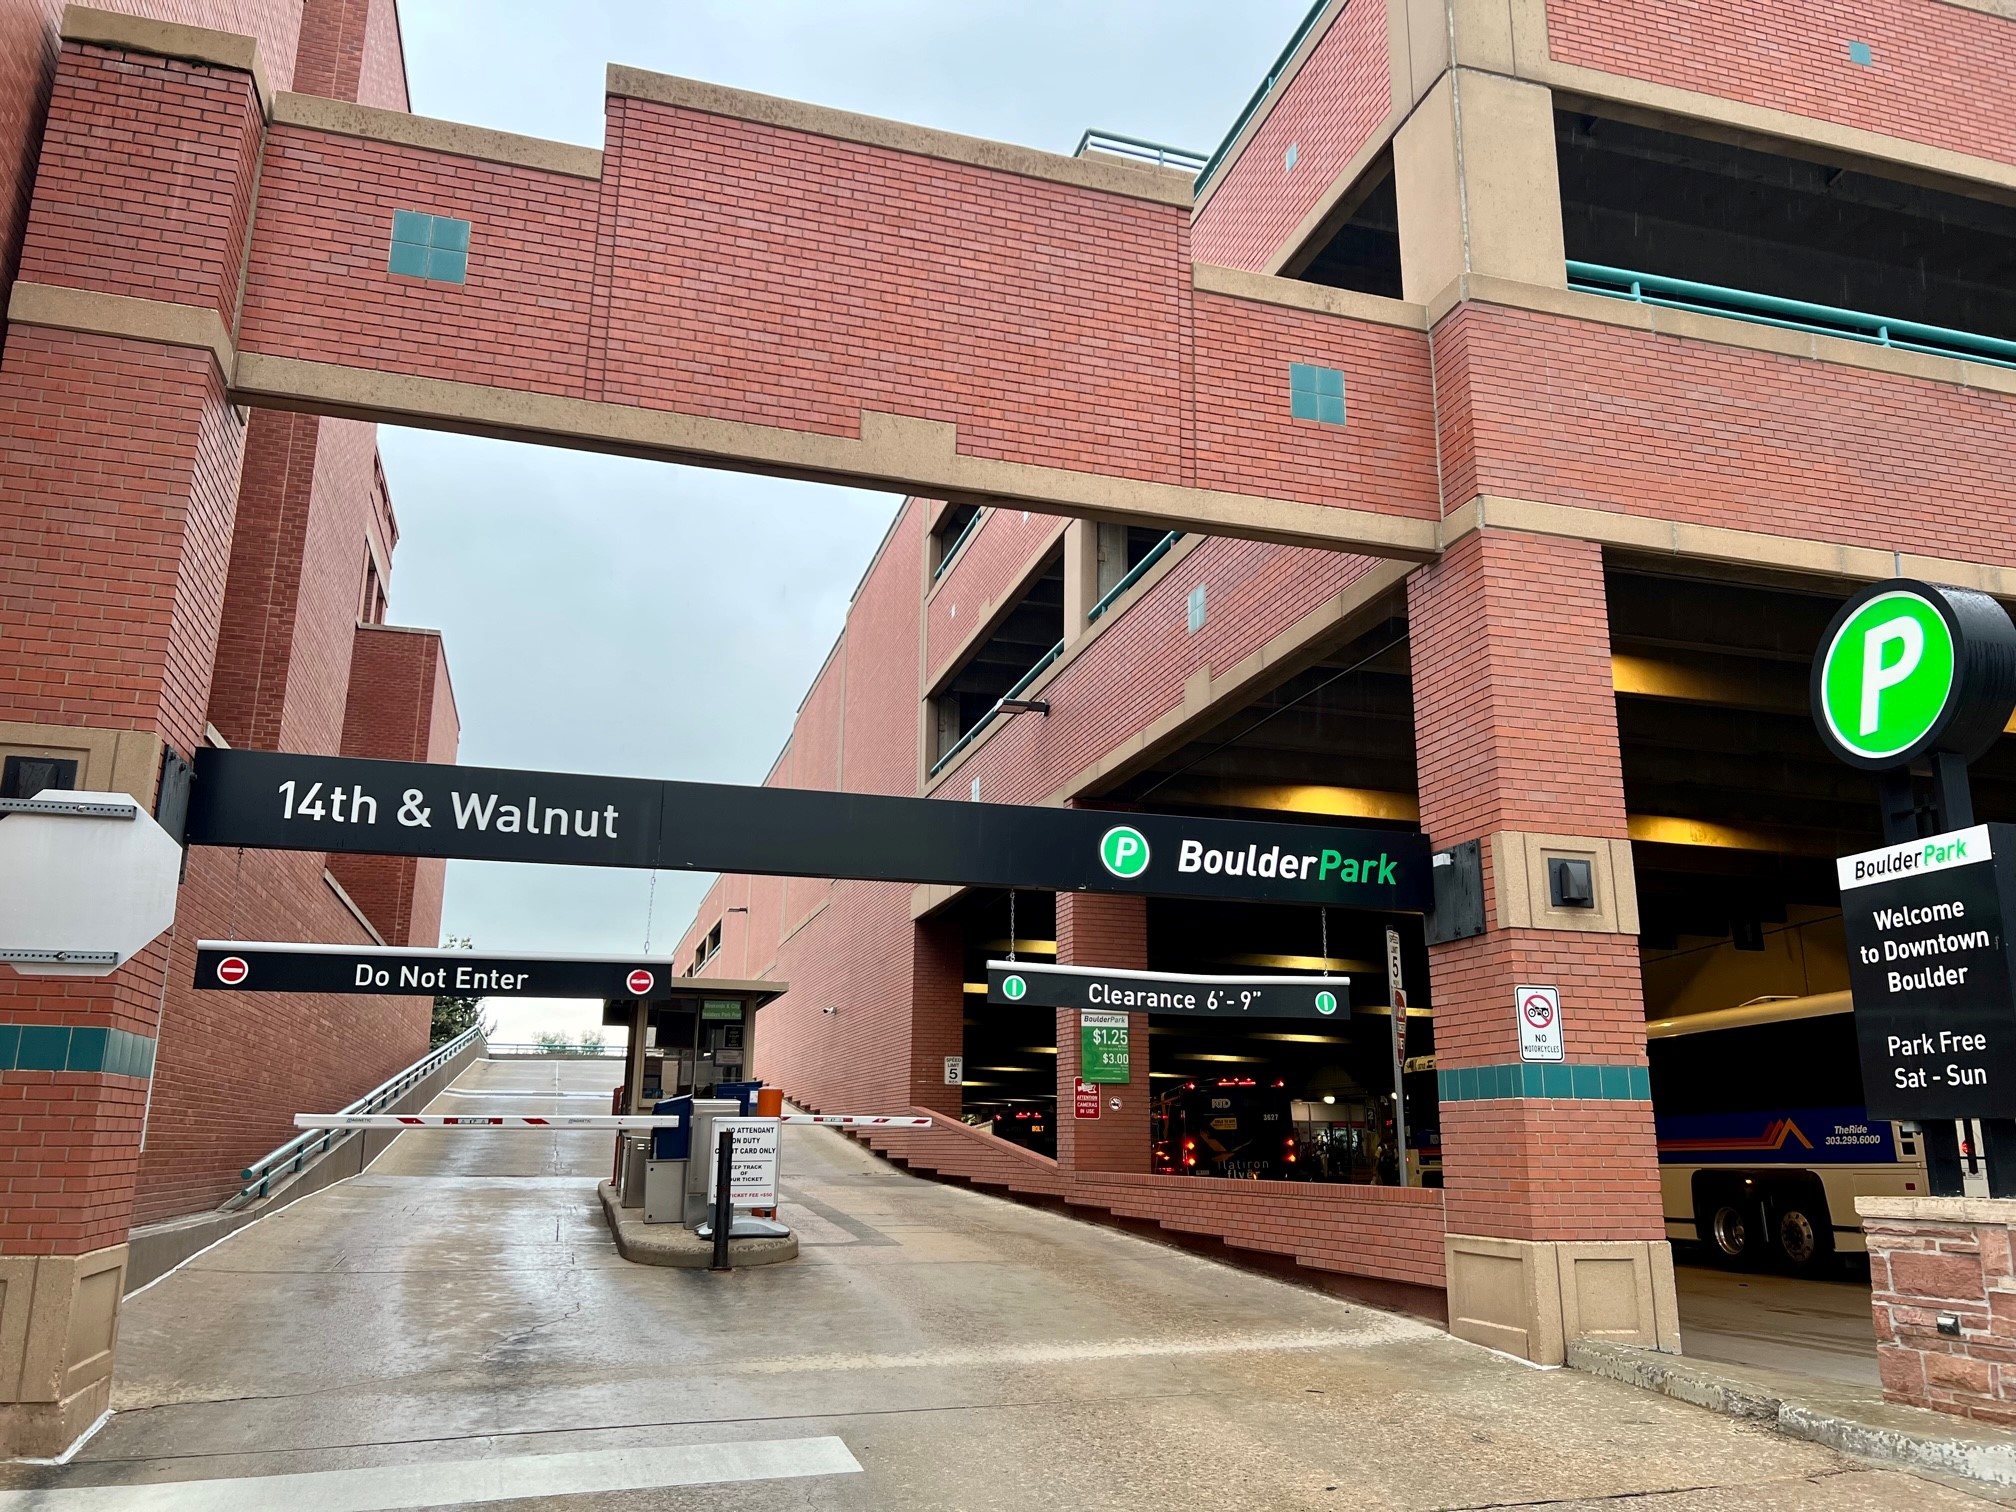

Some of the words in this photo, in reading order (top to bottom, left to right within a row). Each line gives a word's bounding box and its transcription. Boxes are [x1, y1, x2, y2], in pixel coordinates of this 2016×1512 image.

[1859, 615, 1924, 737] P
[278, 780, 378, 824] 14th
[396, 788, 432, 828] &
[450, 791, 619, 839] Walnut
[1115, 836, 1138, 868] P
[1178, 839, 1398, 885] BoulderPark
[1855, 838, 1967, 880] BoulderPark
[1873, 900, 1965, 931] Welcome
[1860, 945, 1880, 964] to
[1883, 929, 1990, 962] Downtown
[355, 963, 390, 987] Do
[400, 965, 447, 988] Not
[455, 966, 529, 990] Enter
[1392, 956, 1399, 978] 5
[1887, 965, 1969, 993] Boulder
[1088, 983, 1196, 1010] Clearance
[1084, 1015, 1126, 1023] BoulderPark
[1092, 1028, 1128, 1045] $1.25
[1524, 1045, 1560, 1053] MOTORCYCLES
[1534, 1034, 1547, 1043] NO
[1887, 1033, 1935, 1057] Park
[1939, 1030, 1987, 1053] Free
[1102, 1052, 1129, 1064] $3.00
[949, 1068, 958, 1080] 5
[1894, 1067, 1927, 1089] Sat
[1946, 1064, 1988, 1086] Sun
[1211, 1098, 1231, 1109] RTD
[1825, 1135, 1881, 1145] 303.299.6000
[1833, 1124, 1868, 1135] TheRide
